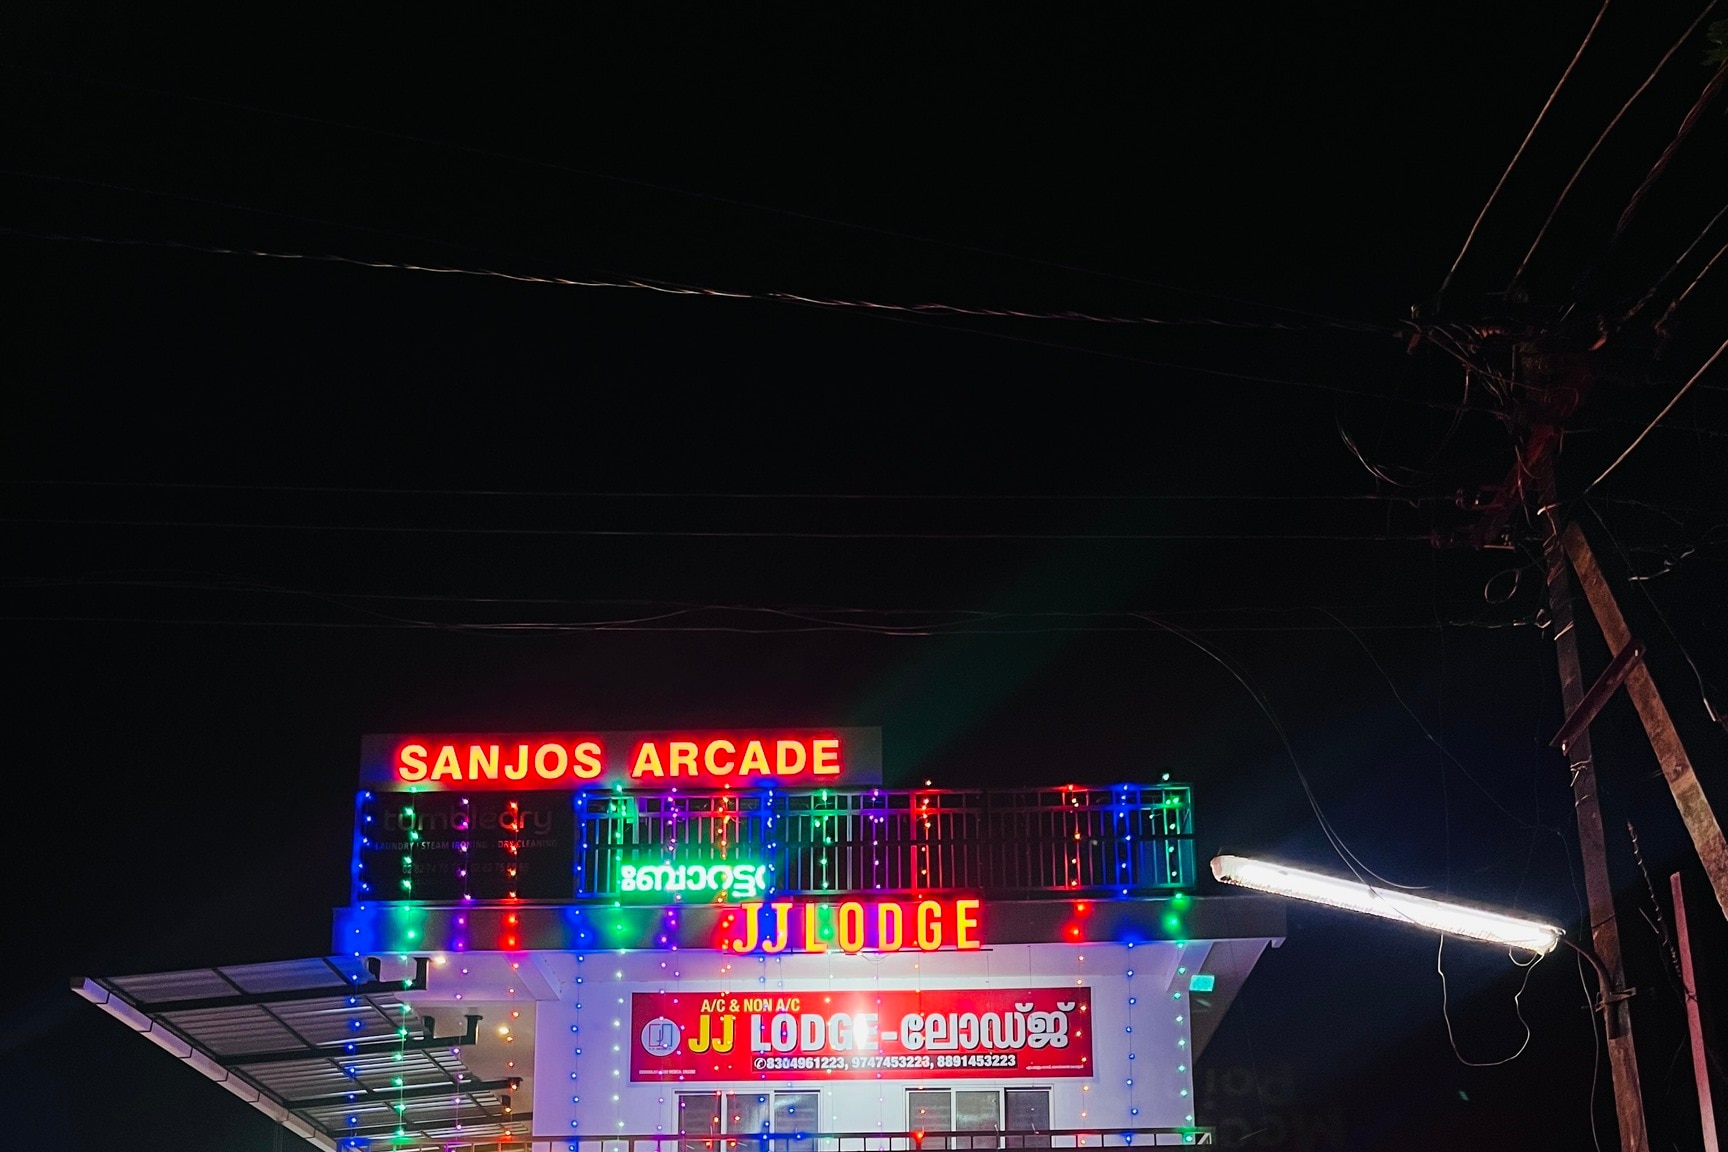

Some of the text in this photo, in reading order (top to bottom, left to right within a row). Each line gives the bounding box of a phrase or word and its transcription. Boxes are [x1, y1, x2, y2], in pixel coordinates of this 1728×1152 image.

[399, 739, 840, 781] SANJOS ARCADE
[383, 805, 553, 835] tumbledry
[375, 841, 414, 851] LAUNDRY
[421, 841, 449, 850] STEAM
[733, 899, 981, 953] JJ LODGE
[700, 997, 801, 1012] A/C & NON A/C
[688, 1014, 735, 1053] JJ
[937, 1054, 1016, 1068] 8891453223
